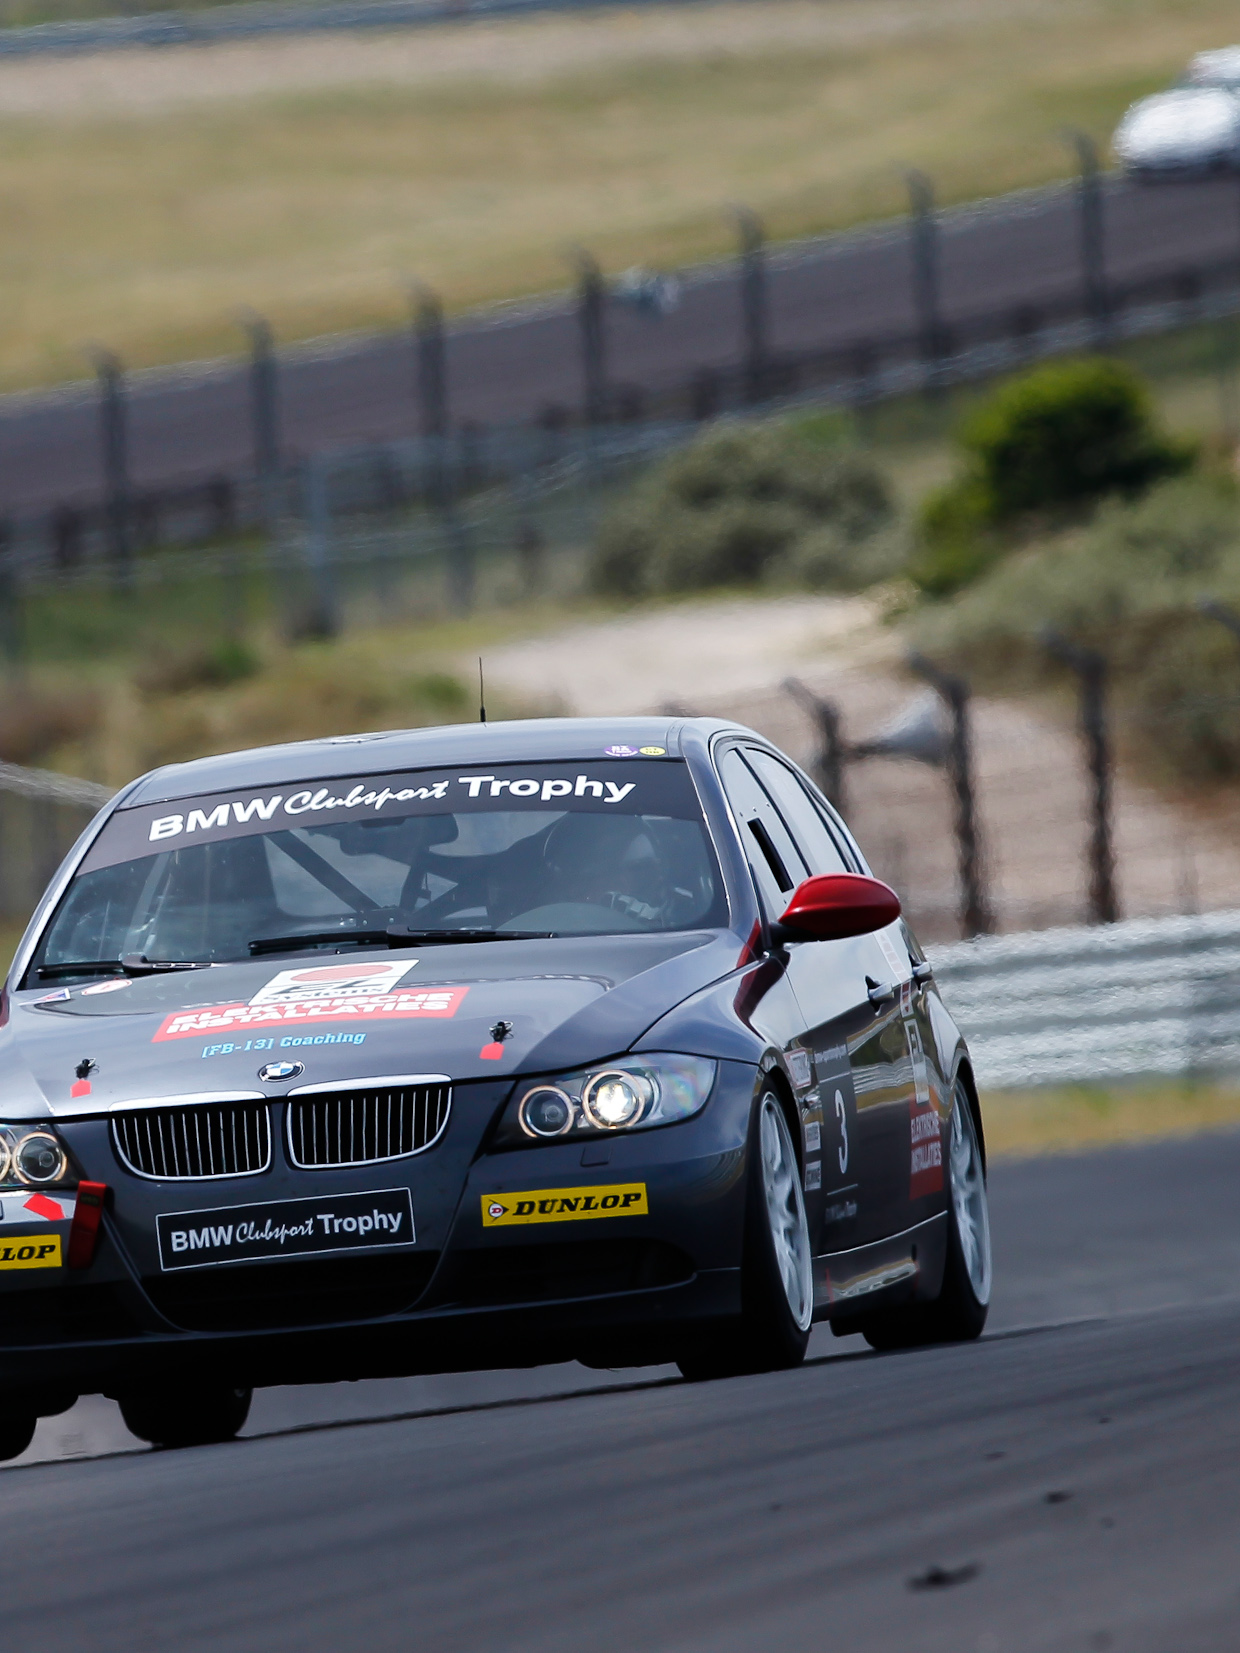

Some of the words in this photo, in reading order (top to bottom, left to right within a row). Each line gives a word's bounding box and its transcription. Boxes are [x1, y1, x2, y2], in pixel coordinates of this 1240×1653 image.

[148, 795, 284, 842] BMW
[282, 780, 450, 811] Clubsport
[458, 774, 637, 804] Trophy
[165, 1001, 450, 1034] INSTALLATIES
[171, 992, 455, 1025] ELEKTRISCHE
[201, 1038, 275, 1059] [FB-13]
[279, 1032, 367, 1047] Coaching
[834, 1088, 849, 1175] 3
[512, 1192, 642, 1216] DUNLOP
[170, 1225, 234, 1252] BMW
[235, 1219, 314, 1245] Clubsport
[317, 1209, 403, 1236] Trophy
